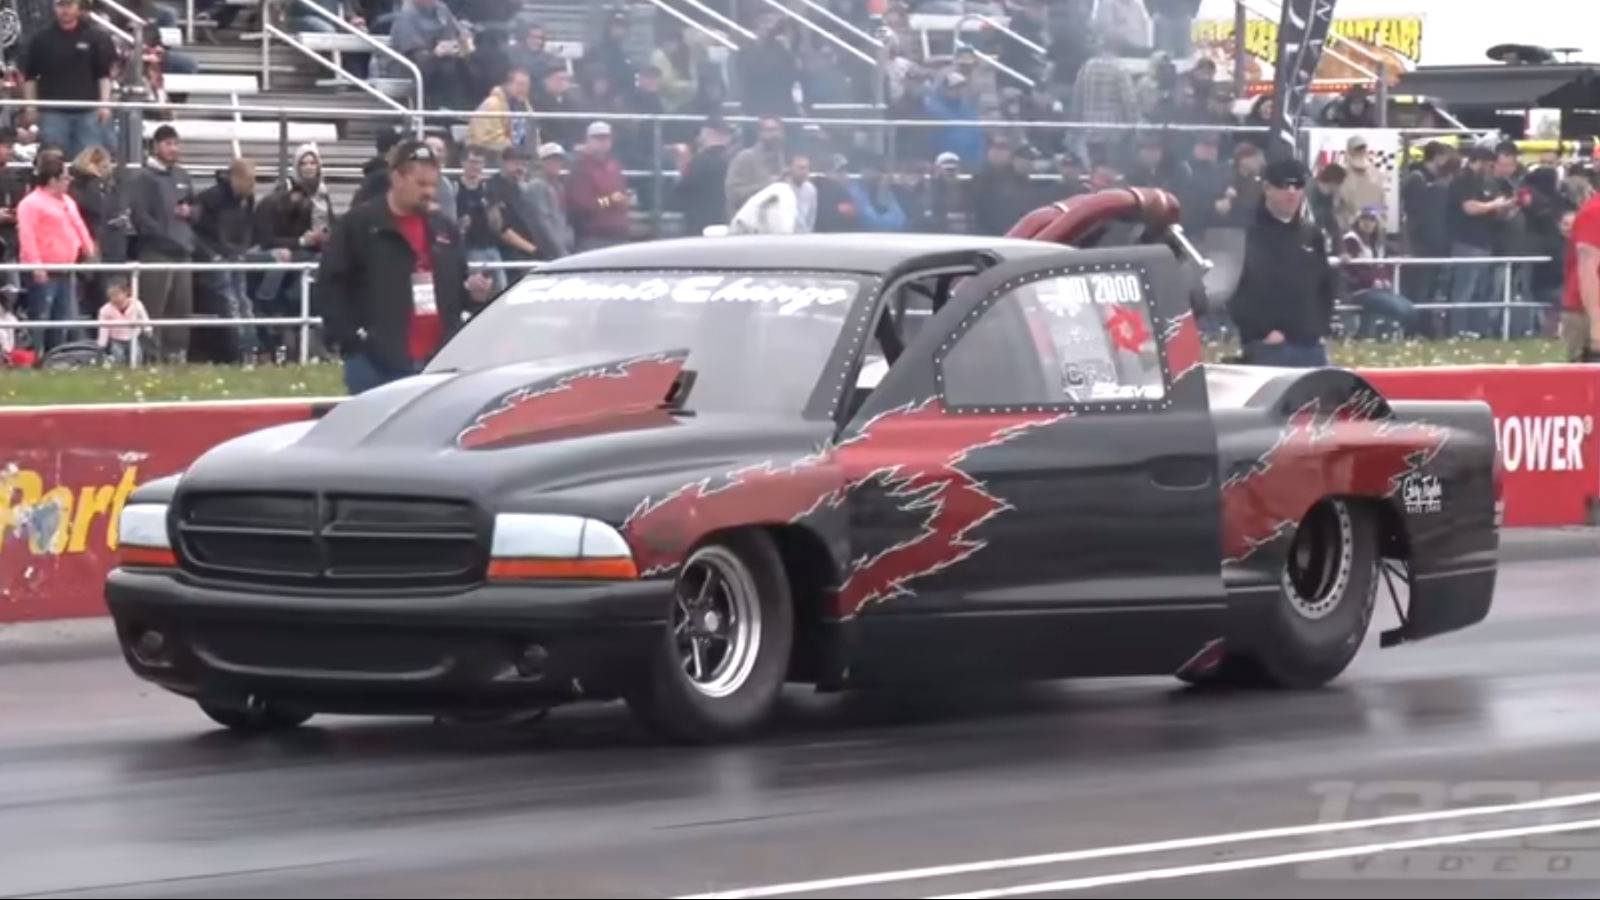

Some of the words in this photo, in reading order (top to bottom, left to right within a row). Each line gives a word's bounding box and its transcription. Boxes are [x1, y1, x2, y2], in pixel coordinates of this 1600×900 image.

[671, 276, 847, 316] Change
[1091, 275, 1141, 303] 2000
[1494, 416, 1584, 472] OWER
